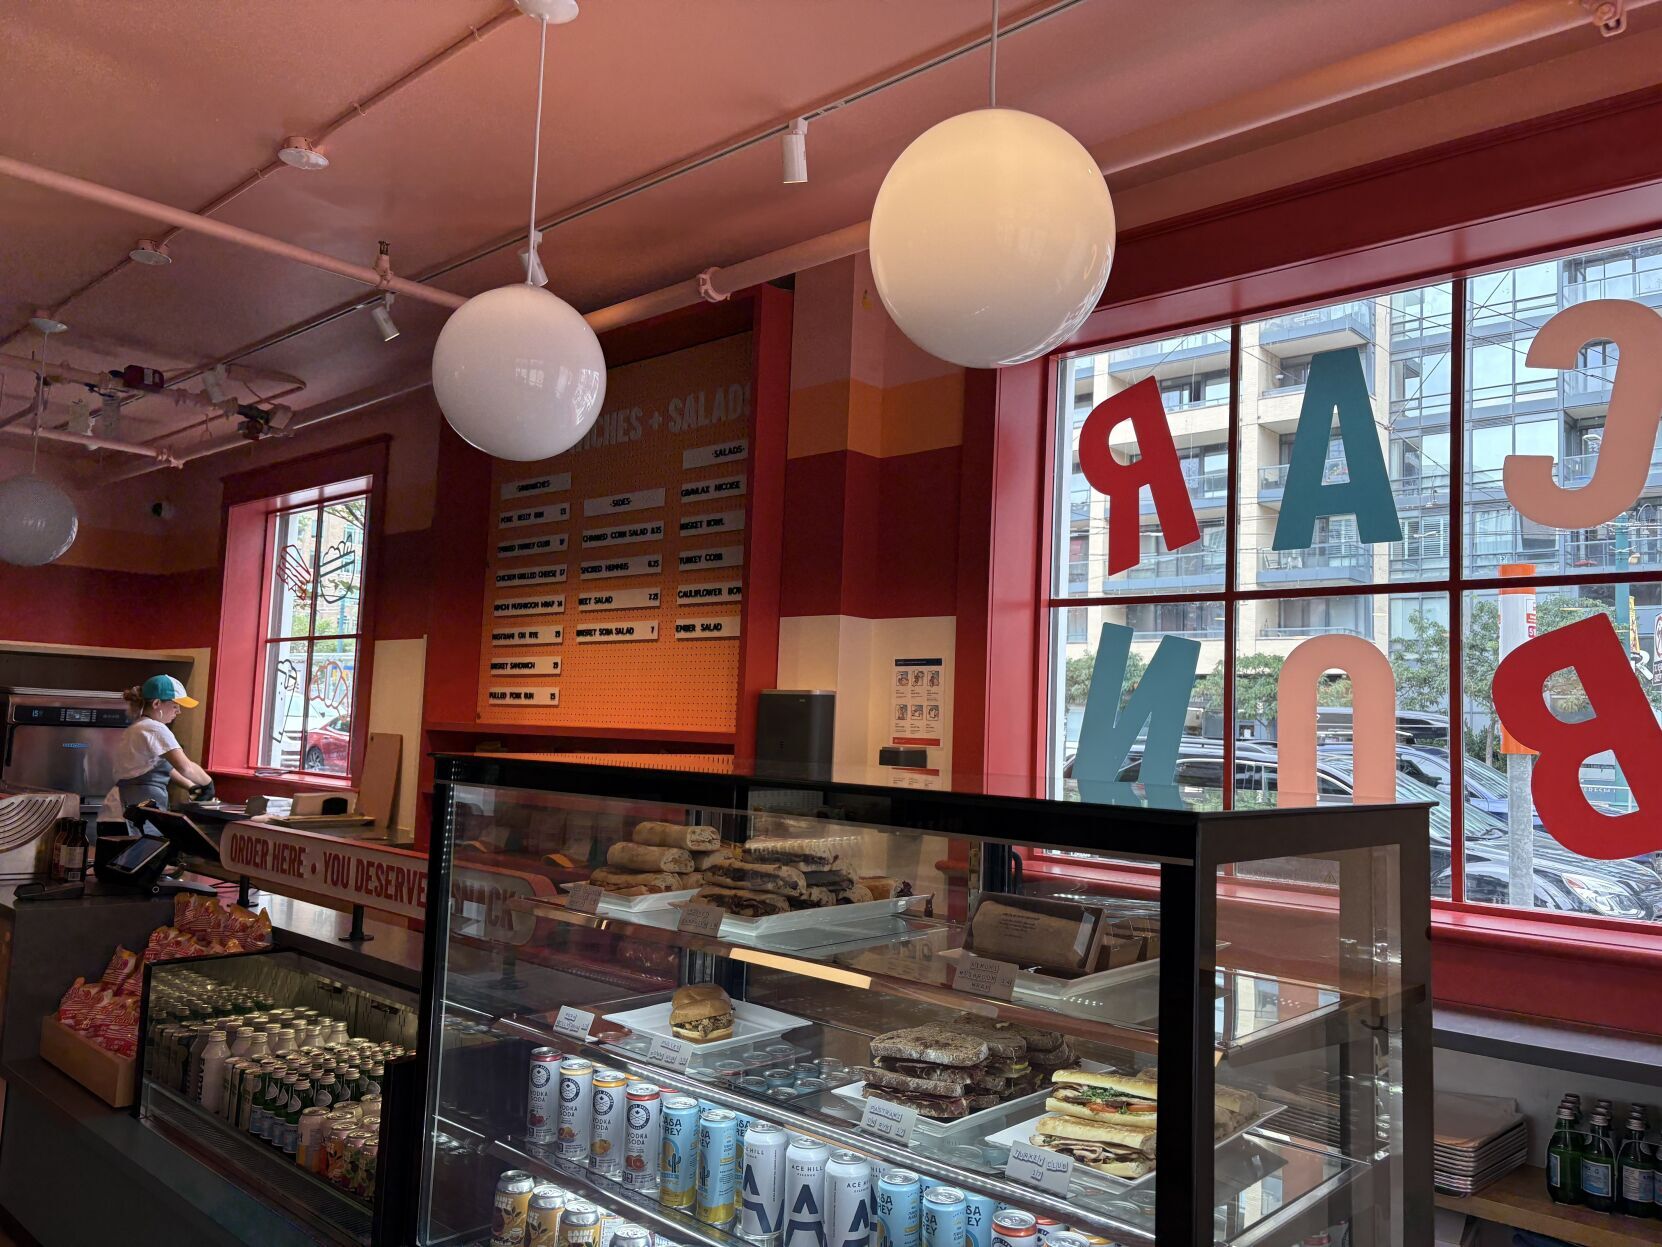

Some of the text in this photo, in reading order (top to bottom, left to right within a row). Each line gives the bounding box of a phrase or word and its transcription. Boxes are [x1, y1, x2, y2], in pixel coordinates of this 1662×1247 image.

[628, 528, 648, 537] SALAD
[677, 586, 742, 598] CAULIFLOWER BOW
[593, 596, 612, 605] SALAD
[614, 627, 634, 635] SALAD
[700, 622, 722, 631] SALAD
[529, 631, 539, 639] RYE
[230, 832, 269, 867] ORDER
[272, 841, 305, 878] HERE
[322, 850, 350, 889] YOU
[355, 858, 428, 907] DESERVE
[870, 1105, 903, 1121] PASTRAMI
[627, 1132, 648, 1140] VODKA
[627, 1138, 645, 1146] SODA
[1013, 1150, 1069, 1171] TURKEY CLUB
[791, 1164, 805, 1172] ACE
[846, 1181, 862, 1190] ACE
